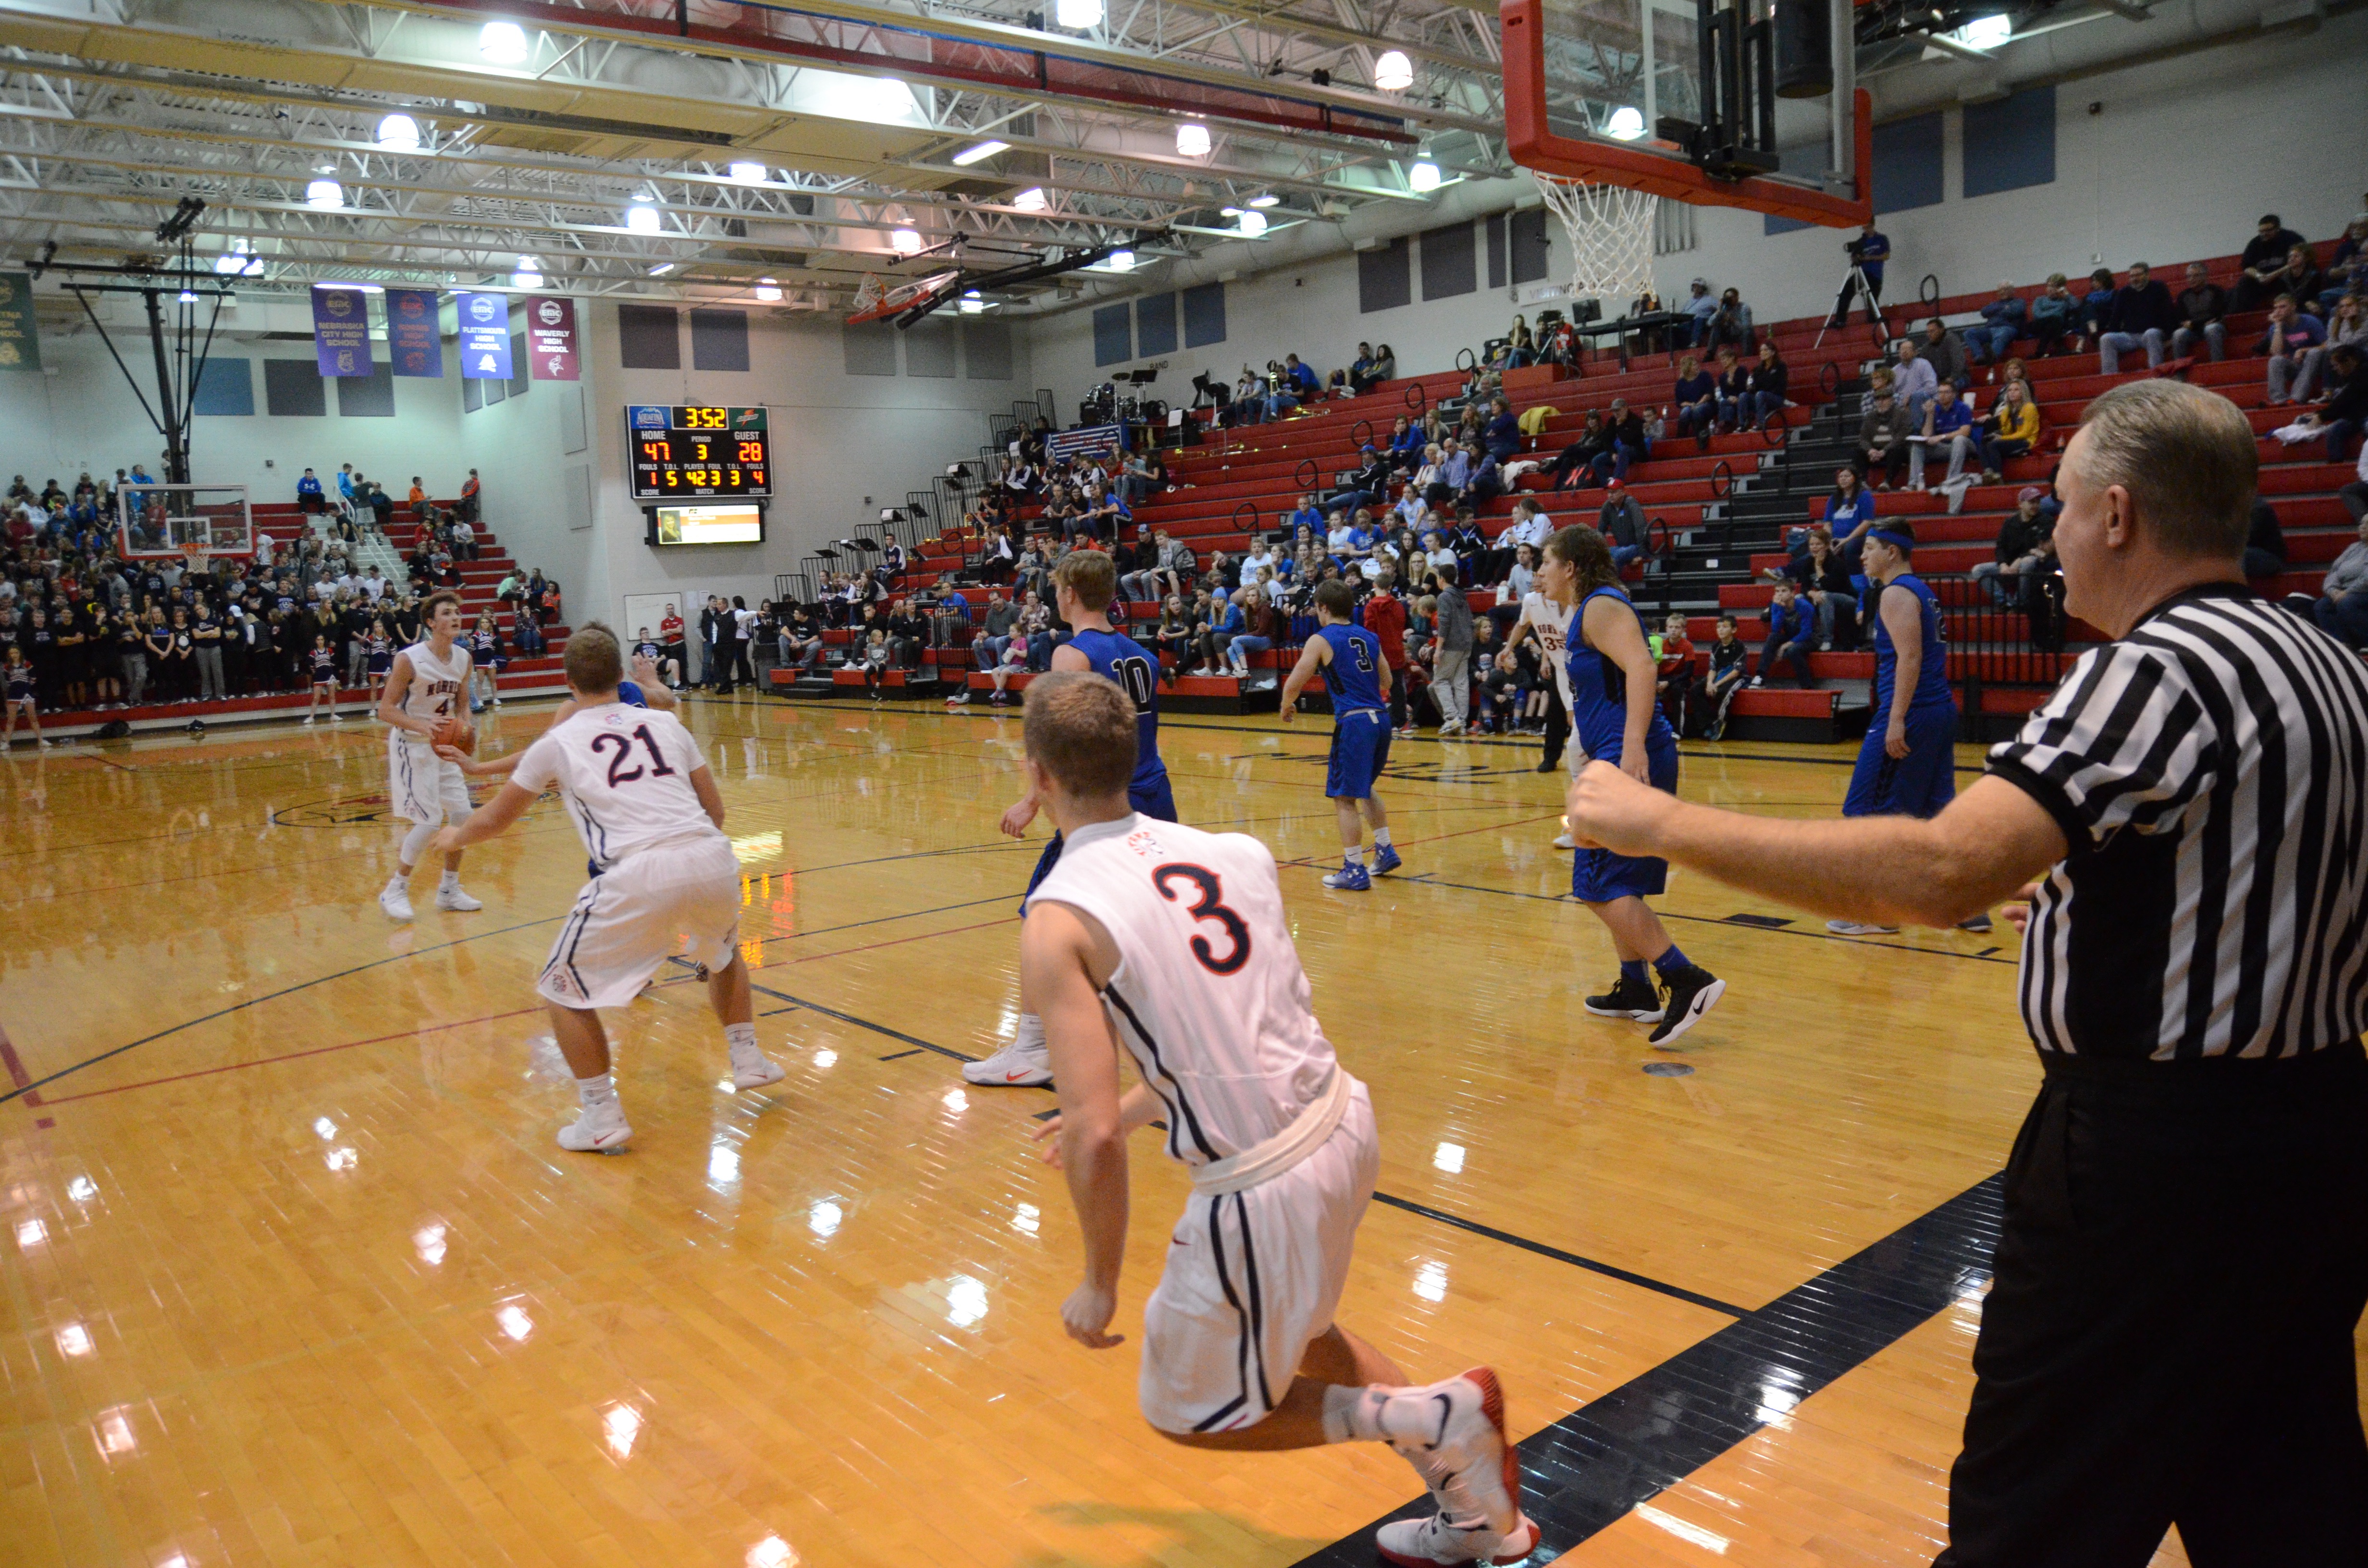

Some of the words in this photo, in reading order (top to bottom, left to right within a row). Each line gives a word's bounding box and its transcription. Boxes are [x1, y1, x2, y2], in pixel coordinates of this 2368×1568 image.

[463, 327, 506, 335] PLATTSMOUTH
[534, 330, 570, 338] WAVERLY
[470, 343, 502, 351] SCHOOL
[538, 345, 569, 353] SCHOOL
[686, 408, 725, 428] 3:52
[641, 431, 666, 440] HOME
[735, 431, 760, 440] GUEST
[644, 442, 670, 461] 47
[697, 444, 707, 460] 3
[739, 442, 762, 462] 28
[651, 472, 657, 485] 1
[666, 470, 678, 486] 5
[686, 470, 707, 486] 42
[711, 470, 720, 486] 3
[730, 470, 740, 486] 3
[752, 471, 764, 484] 4
[1544, 637, 1566, 651] 35
[1348, 637, 1373, 672] 3
[1110, 656, 1152, 715] 10
[435, 698, 448, 716] 4
[592, 723, 676, 788] 21
[1151, 862, 1252, 976] 3
